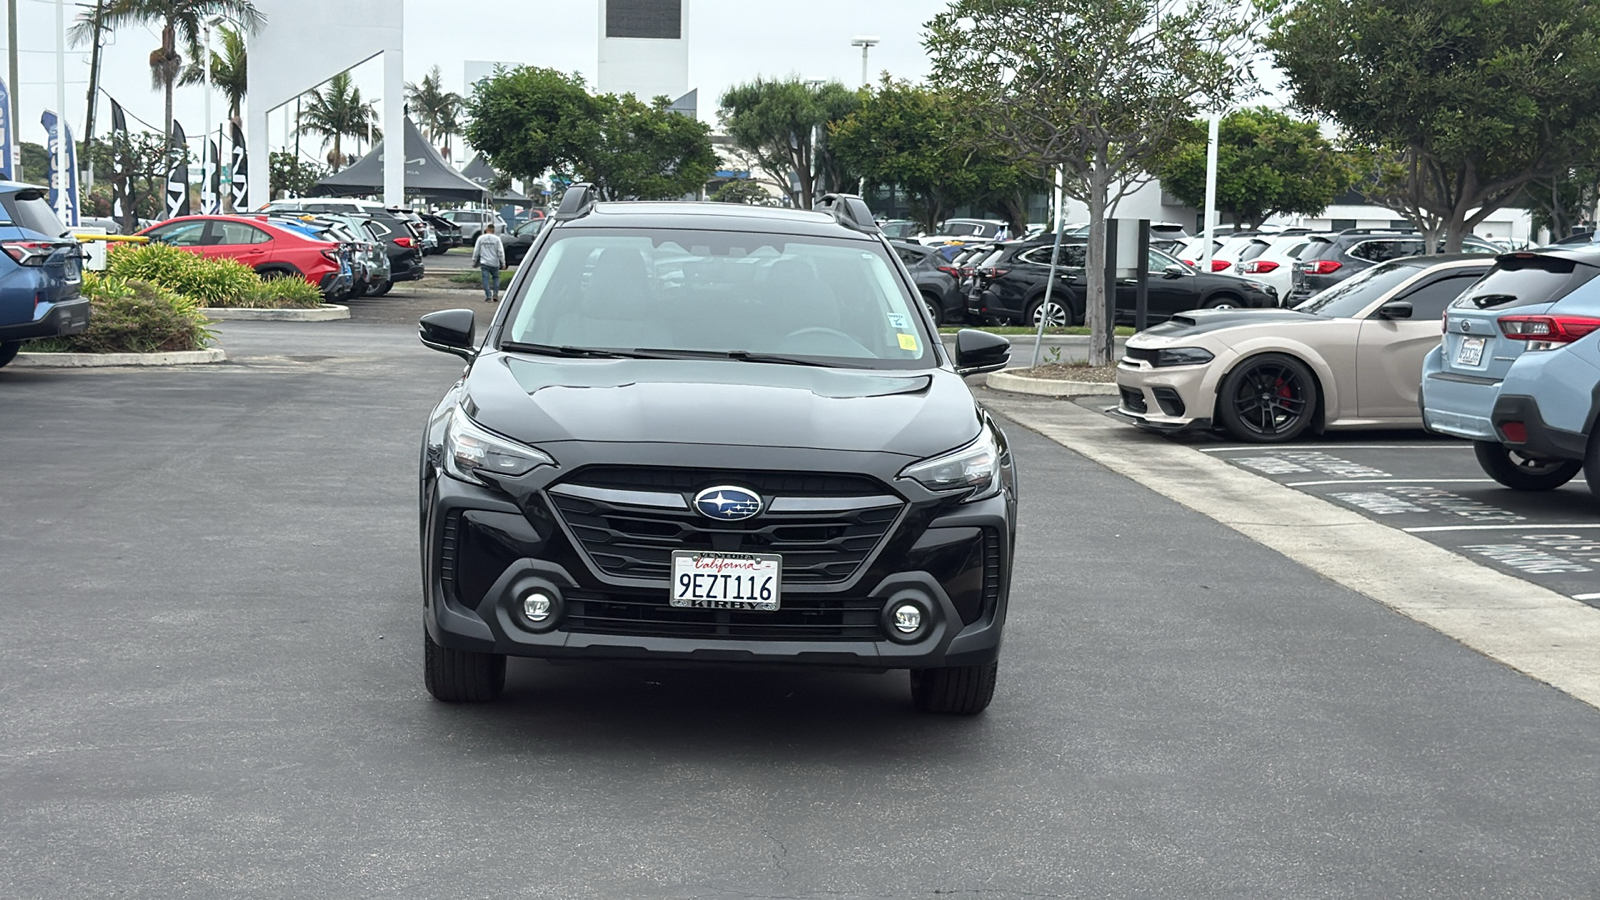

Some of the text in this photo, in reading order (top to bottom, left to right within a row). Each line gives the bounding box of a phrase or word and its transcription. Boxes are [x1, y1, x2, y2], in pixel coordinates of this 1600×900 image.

[694, 557, 761, 573] California
[678, 573, 773, 600] 9EZT116
[691, 599, 760, 610] KIRBY
